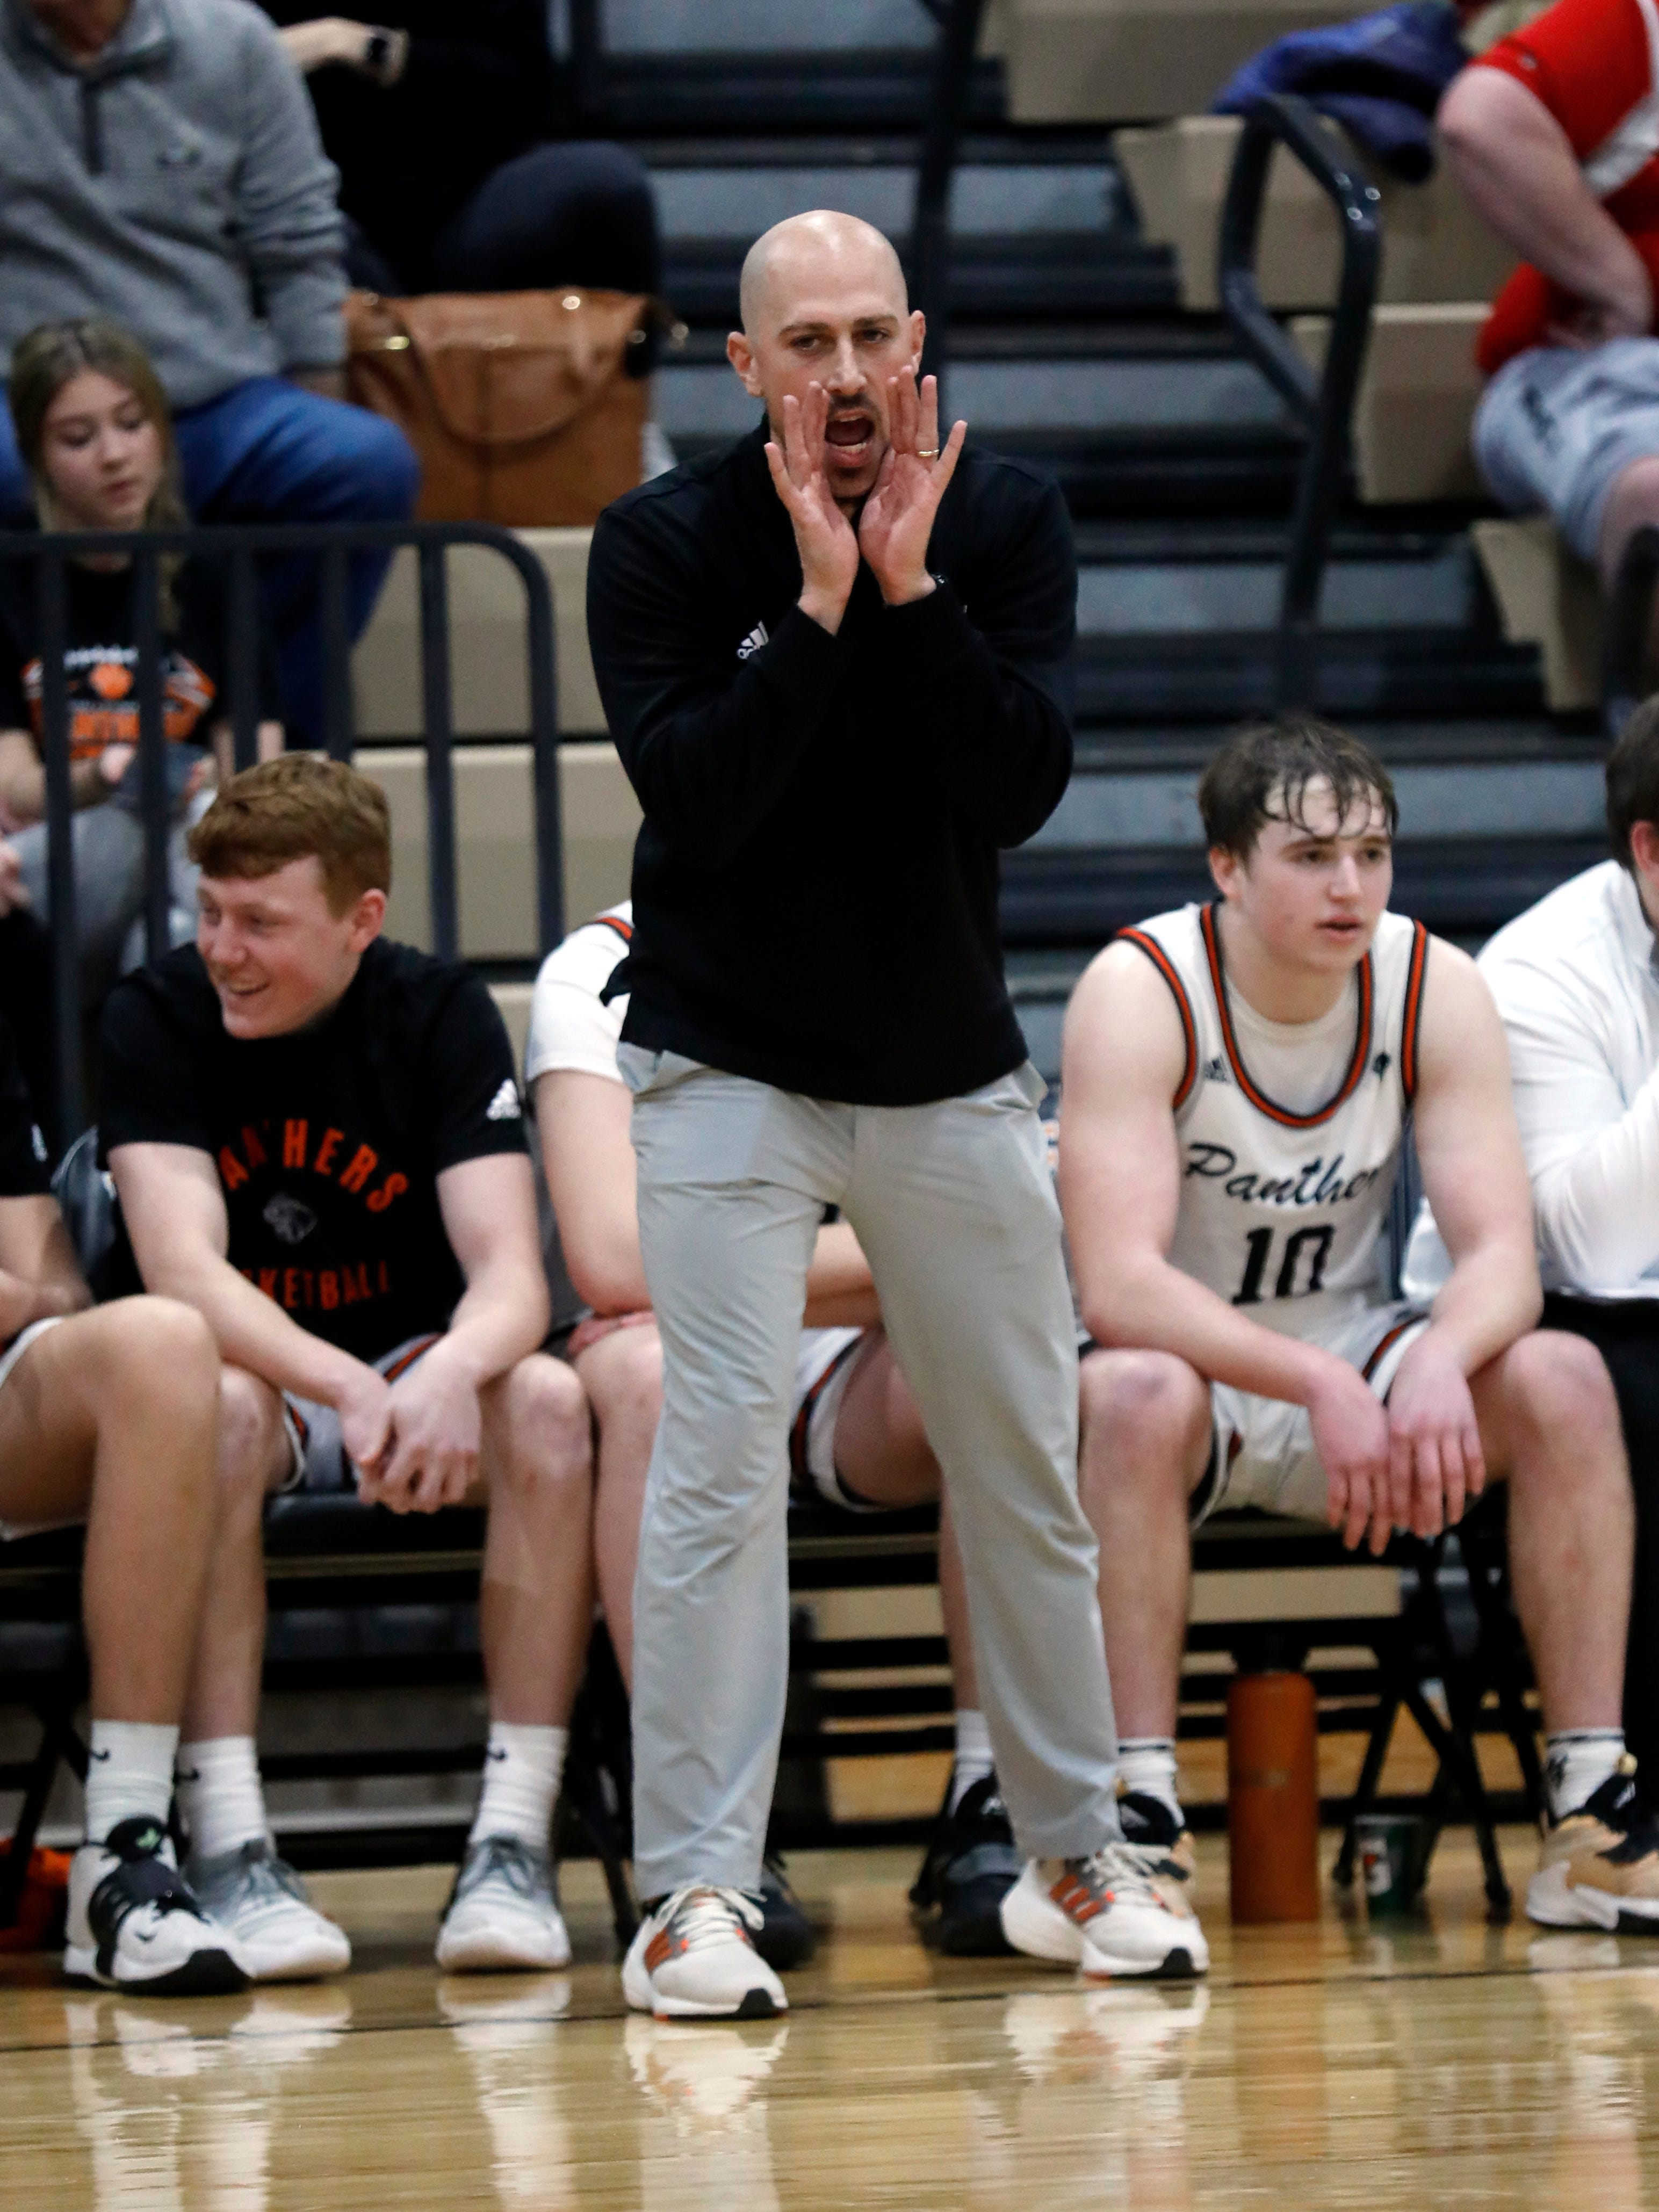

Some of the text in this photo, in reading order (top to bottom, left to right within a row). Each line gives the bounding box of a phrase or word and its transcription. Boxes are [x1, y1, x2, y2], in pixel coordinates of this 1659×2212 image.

[219, 1117, 409, 1213] ANHERS
[240, 1260, 391, 1311] KETBALL
[1232, 1223, 1336, 1306] 10
